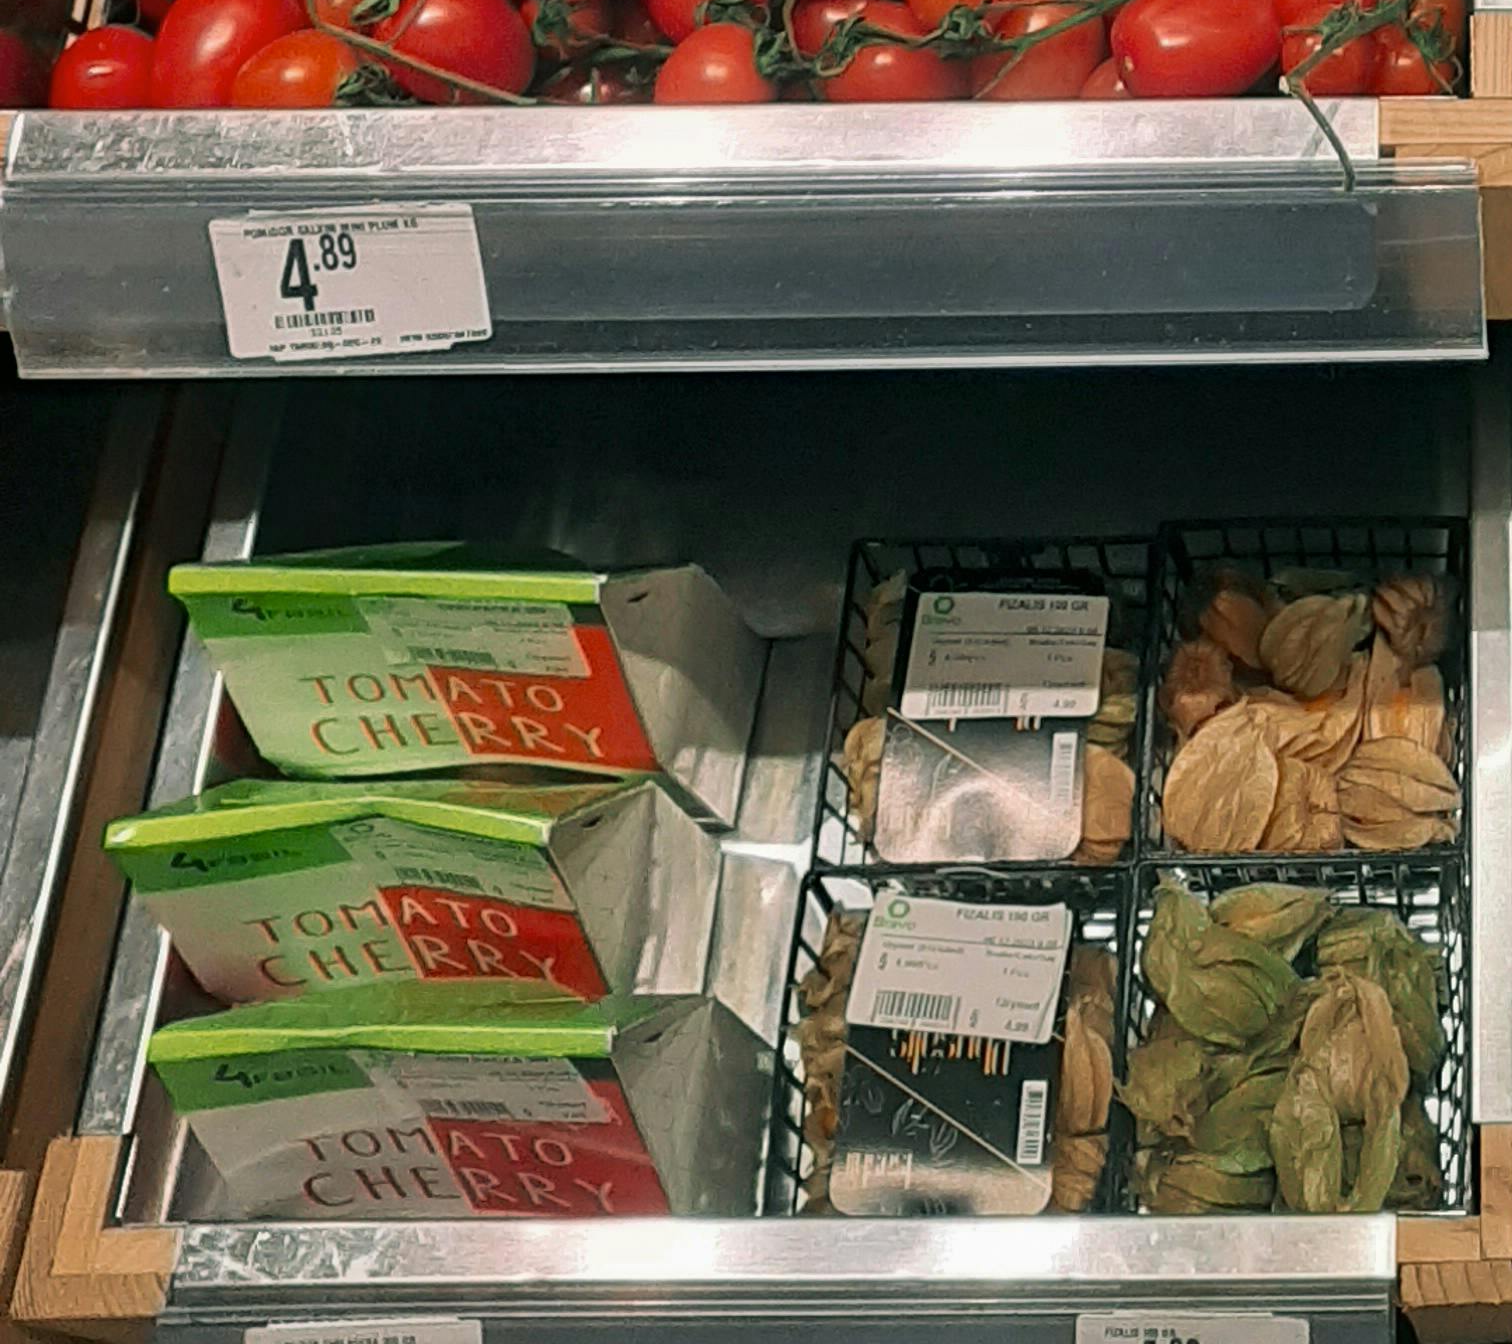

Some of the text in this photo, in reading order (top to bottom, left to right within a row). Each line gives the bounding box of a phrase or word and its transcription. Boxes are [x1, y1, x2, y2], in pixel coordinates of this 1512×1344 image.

[280, 233, 357, 311] 4.89
[300, 671, 566, 713] TOMATO
[310, 711, 605, 758] CHERRY
[243, 895, 517, 945] TOMATO
[257, 934, 566, 989] CHERRY
[299, 1127, 573, 1166] TOMATO
[302, 1166, 616, 1213] CHERRY
